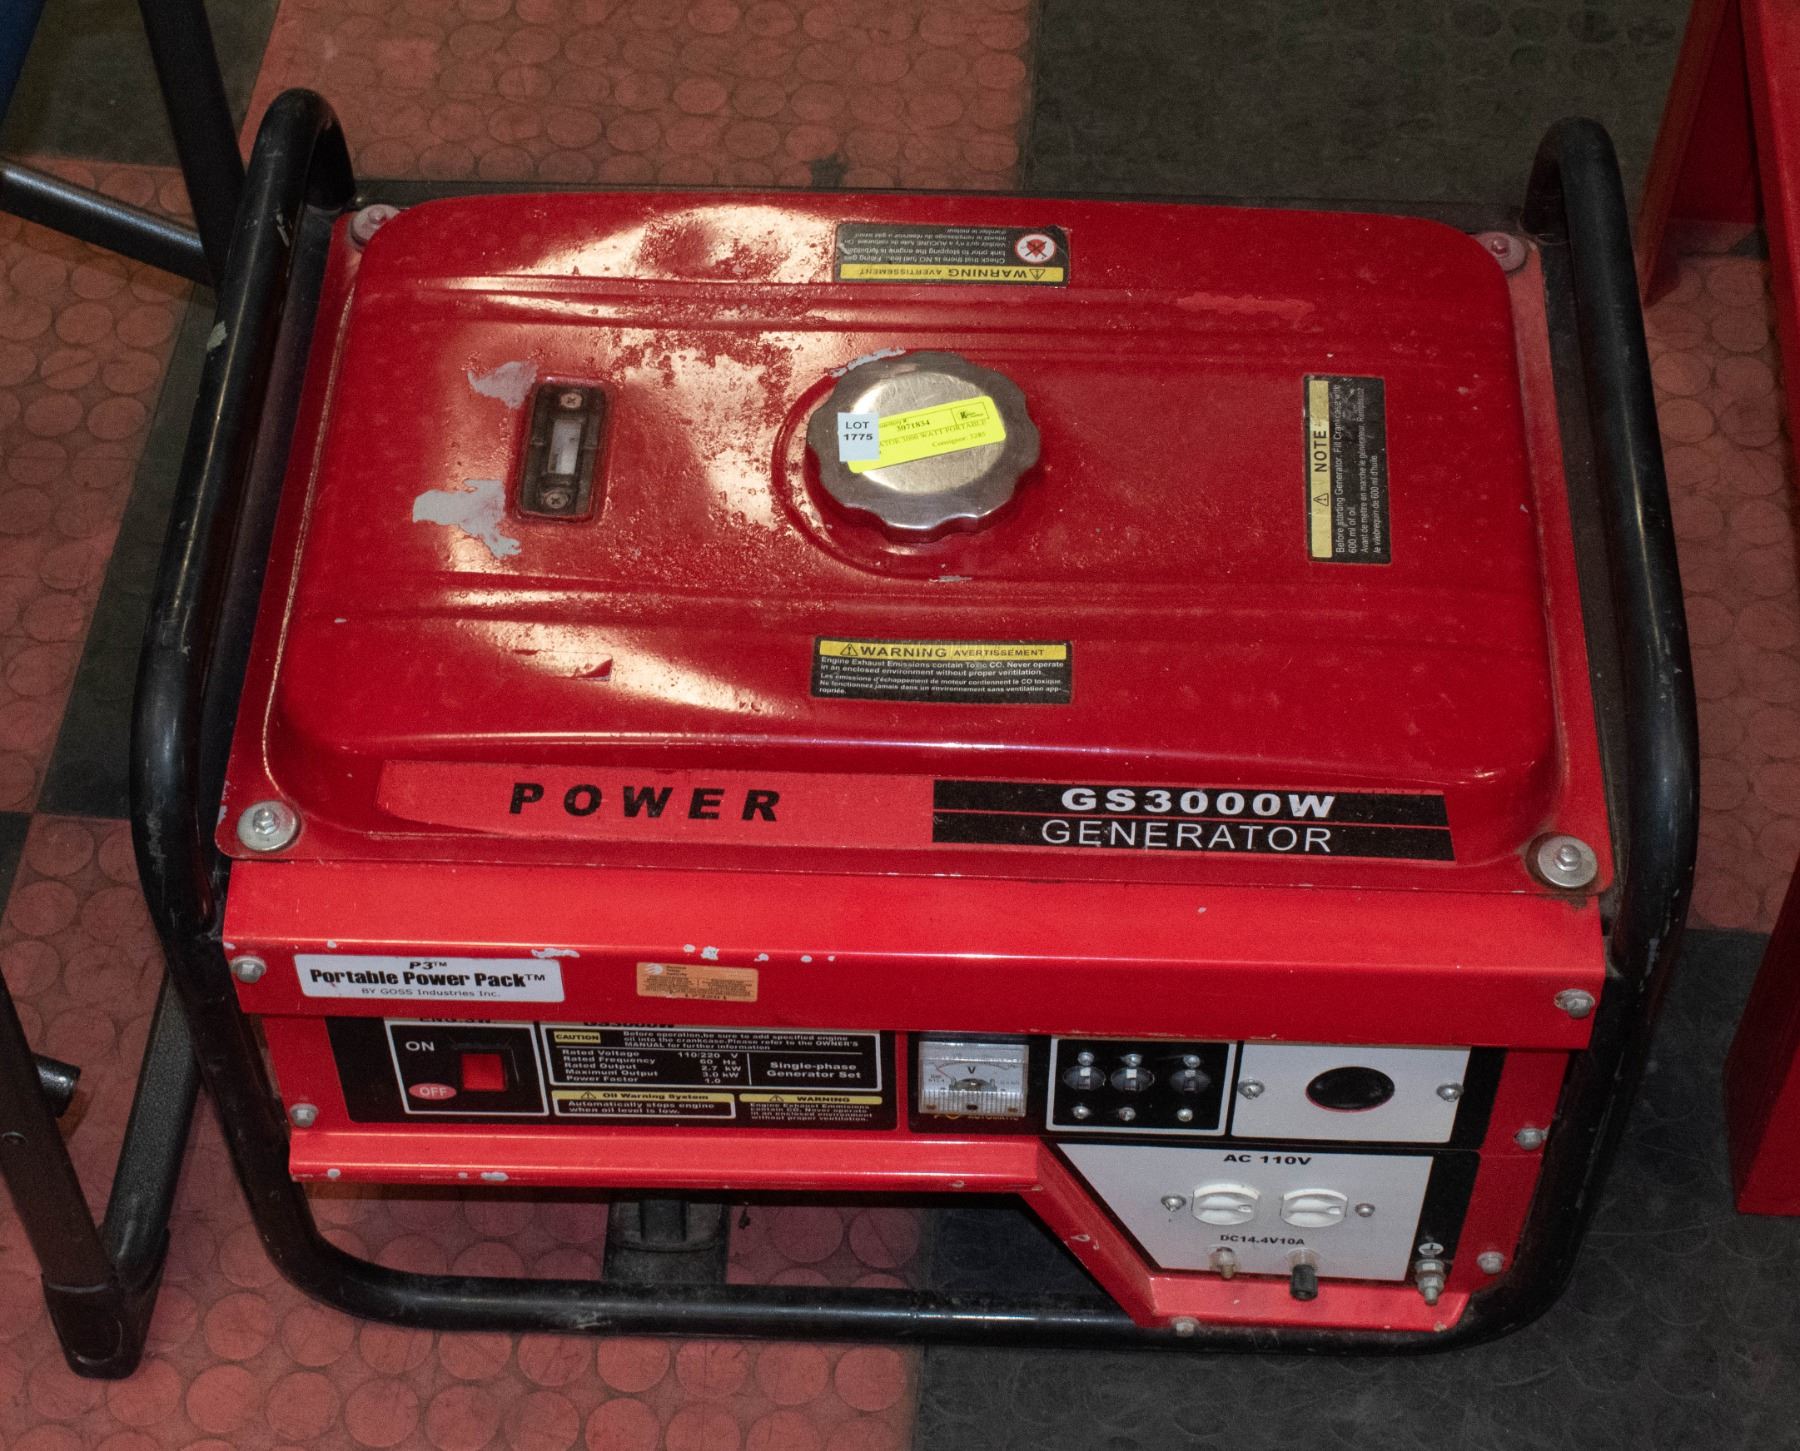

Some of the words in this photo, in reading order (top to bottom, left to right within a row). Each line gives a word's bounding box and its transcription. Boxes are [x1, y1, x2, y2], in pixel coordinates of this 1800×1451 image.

[890, 247, 914, 255] engine
[929, 247, 960, 256] stopping
[971, 248, 988, 256] prior
[859, 268, 942, 276] AVERTISSEMENT
[948, 269, 1028, 279] WARNING
[845, 421, 870, 430] LOT
[844, 433, 873, 441] 1775
[1313, 431, 1327, 473] NOTE
[1333, 441, 1342, 453] Fill
[1370, 477, 1378, 486] ml
[1360, 492, 1367, 501] en
[1370, 486, 1379, 499] 600
[1372, 500, 1380, 509] de
[1335, 498, 1346, 526] starting
[1347, 517, 1357, 526] of
[1348, 527, 1357, 537] ml
[1360, 524, 1368, 533] de
[1335, 527, 1345, 553] Before
[1360, 534, 1369, 553] Avant
[1348, 539, 1357, 554] 600
[1372, 546, 1381, 554] le
[860, 645, 947, 658] WARNING
[953, 648, 1045, 657] AVERTISSEMENT
[821, 656, 849, 666] Engine
[852, 658, 885, 666] Exhaust
[887, 659, 930, 668] Emissions
[932, 660, 963, 669] contain
[989, 661, 1005, 669] CO.
[1006, 661, 1032, 669] Never
[1033, 661, 1064, 670] operate
[843, 665, 880, 674] enclosed
[881, 667, 934, 676] environment
[935, 669, 967, 677] without
[968, 670, 996, 678] proper
[820, 672, 833, 680] Les
[939, 678, 966, 686] moteur
[1012, 678, 1019, 686] le
[900, 683, 918, 691] dans
[1007, 685, 1044, 693] ventilation
[509, 782, 780, 822] POWER
[1061, 787, 1336, 818] GS3000W
[1041, 818, 1332, 852] GENERATOR
[310, 969, 399, 985] Portable
[403, 971, 471, 987] Power
[361, 988, 379, 996] BY
[380, 988, 413, 997] GOSS
[417, 988, 478, 998] Industries
[480, 989, 501, 998] Inc.
[556, 1033, 600, 1041] CAUTION
[761, 1038, 782, 1046] refer
[772, 1033, 815, 1042] specified
[405, 1040, 435, 1051] ON
[717, 1043, 771, 1051] information
[598, 1050, 640, 1058] Voltage
[598, 1055, 656, 1065] Frequency
[600, 1063, 638, 1071] Output
[770, 1061, 857, 1071] Single-phase
[967, 1066, 977, 1075] V
[565, 1068, 618, 1076] Maximum
[621, 1069, 658, 1078] Output
[702, 1071, 719, 1079] 3.0
[767, 1070, 835, 1079] Generator
[839, 1071, 862, 1079] Set
[419, 1086, 448, 1097] OFF
[620, 1092, 666, 1100] Warning
[568, 1101, 643, 1109] Automatically
[1223, 1154, 1252, 1163] AC
[1259, 1155, 1312, 1165] 110V
[1220, 1234, 1305, 1245] DC14.4V10A
